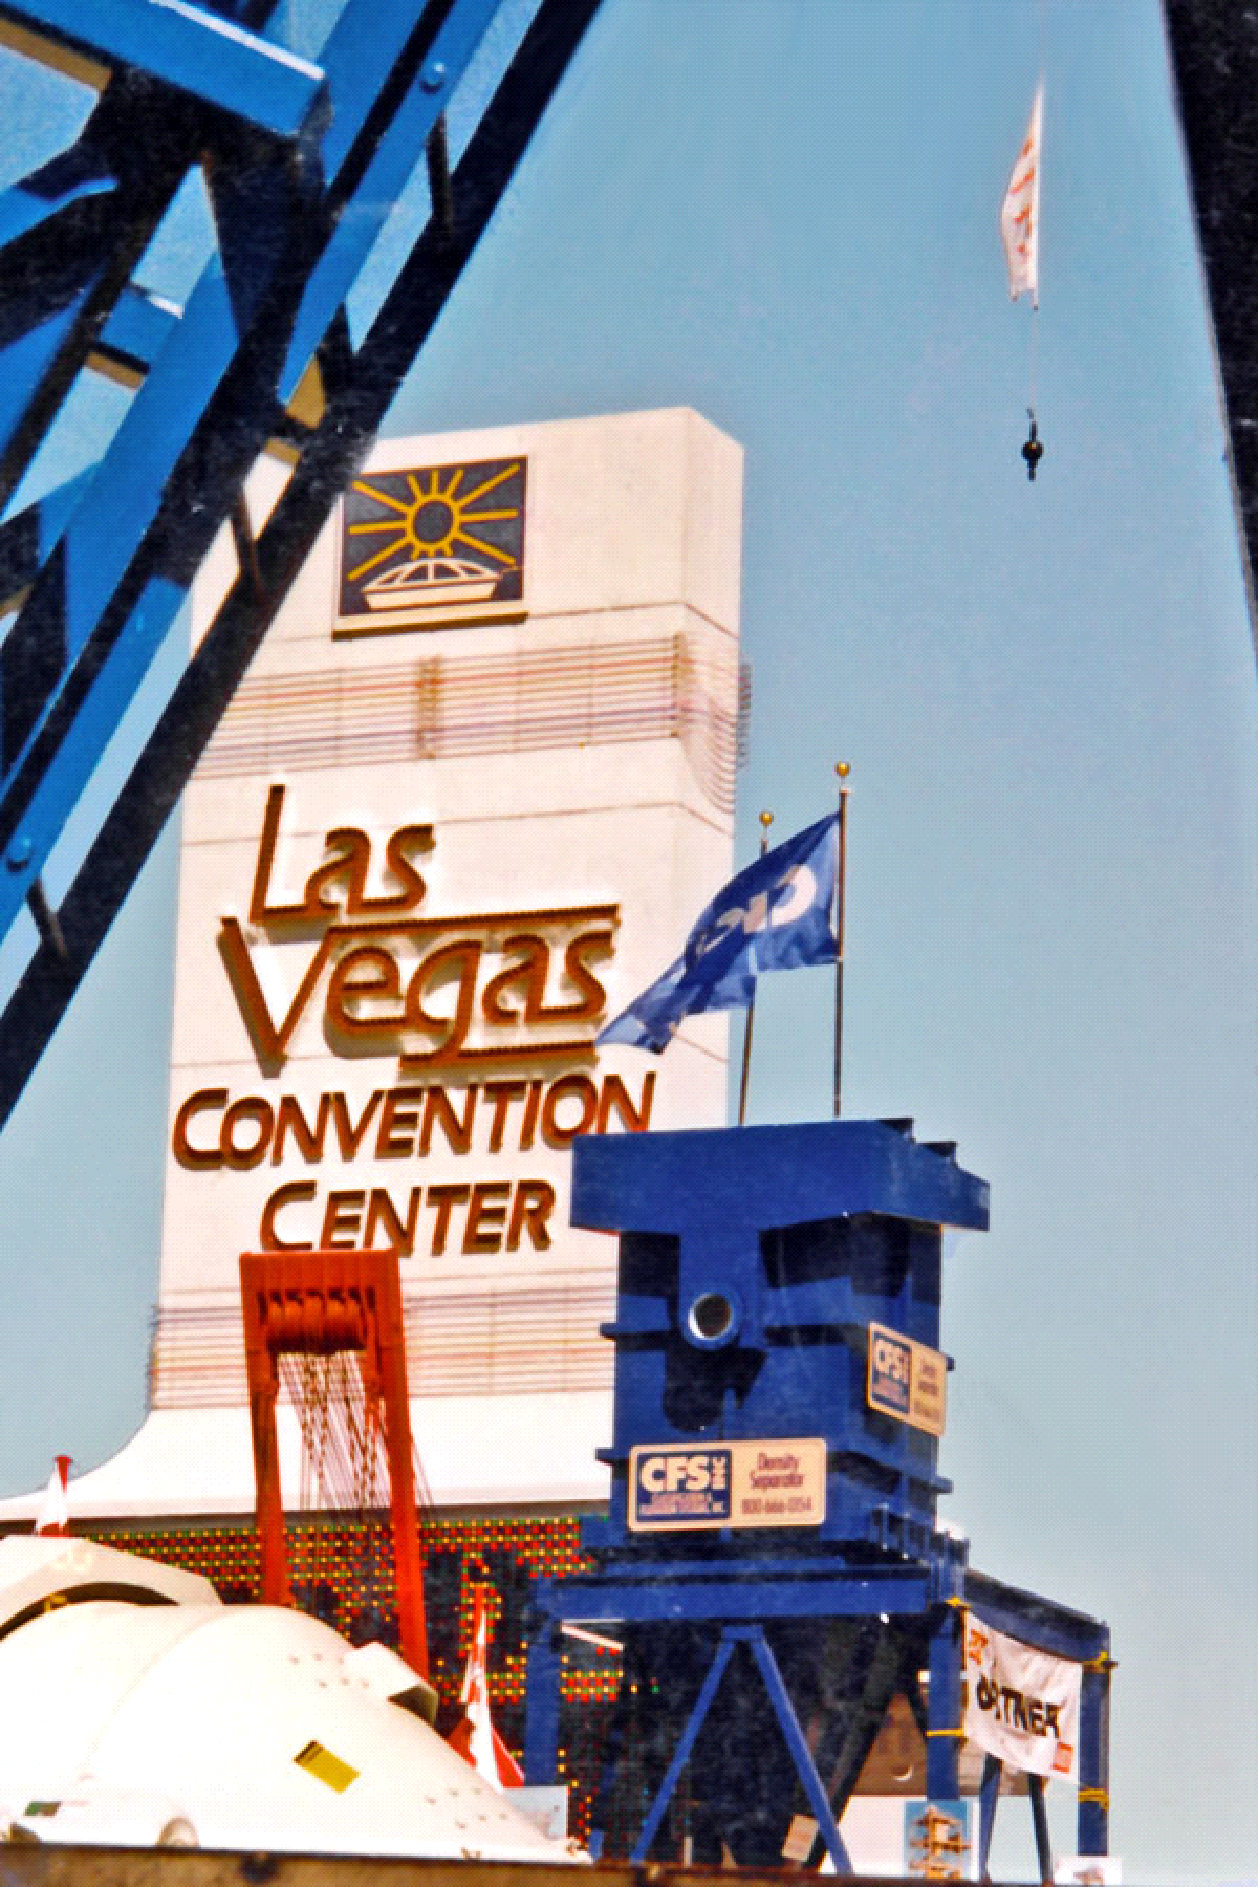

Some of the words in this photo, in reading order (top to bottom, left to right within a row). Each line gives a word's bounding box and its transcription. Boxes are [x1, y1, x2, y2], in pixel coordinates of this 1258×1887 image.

[250, 783, 436, 930] Las
[216, 903, 621, 1077] Vegas
[172, 1070, 657, 1171] CONVENTION
[260, 1179, 556, 1258] CENTER
[641, 1455, 710, 1492] CFS
